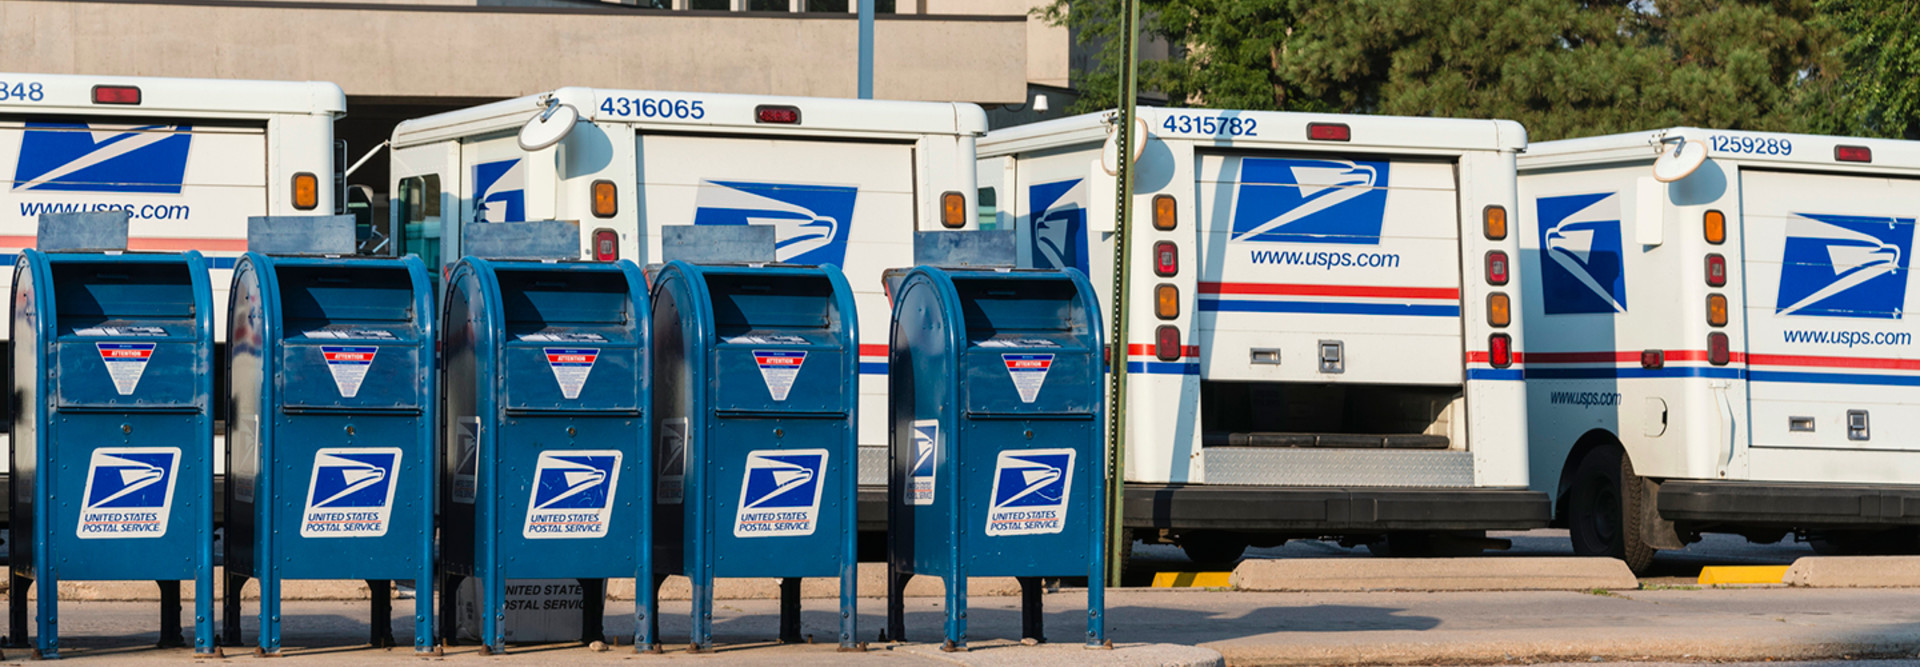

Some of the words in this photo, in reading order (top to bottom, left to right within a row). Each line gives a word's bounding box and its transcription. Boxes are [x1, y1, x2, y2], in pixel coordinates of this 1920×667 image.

[600, 97, 704, 120] 4316065
[1163, 114, 1257, 136] 4315782
[1709, 135, 1792, 156] 1259289
[20, 202, 190, 220] wwwuss.com
[1250, 250, 1400, 270] www.usps.com
[1784, 330, 1912, 348] www.usps.com
[1550, 392, 1622, 409] www.usps.com
[84, 513, 122, 522] UNITED
[124, 512, 157, 521] STATES
[308, 512, 345, 521] UNITED
[346, 512, 379, 520] STATES
[531, 514, 566, 522] UNITED
[567, 514, 599, 522] STATES
[741, 513, 775, 521] UNITED
[776, 512, 807, 520] STATES
[992, 512, 1025, 521] UNITED
[1026, 510, 1056, 519] STATES
[82, 524, 118, 532] POSTAL
[121, 523, 159, 532] SERVICE
[306, 523, 340, 531] POSTAL
[343, 522, 381, 531] SERVICE
[565, 524, 601, 532] SERVICE
[739, 523, 772, 531] POSTAL
[774, 522, 809, 531] SERVICE
[990, 522, 1022, 530] POSTAL
[1024, 520, 1058, 529] SERVICE
[505, 585, 540, 595] NITED
[544, 585, 582, 595] STATE
[505, 600, 540, 610] STAL
[543, 600, 583, 610] SERVIC
